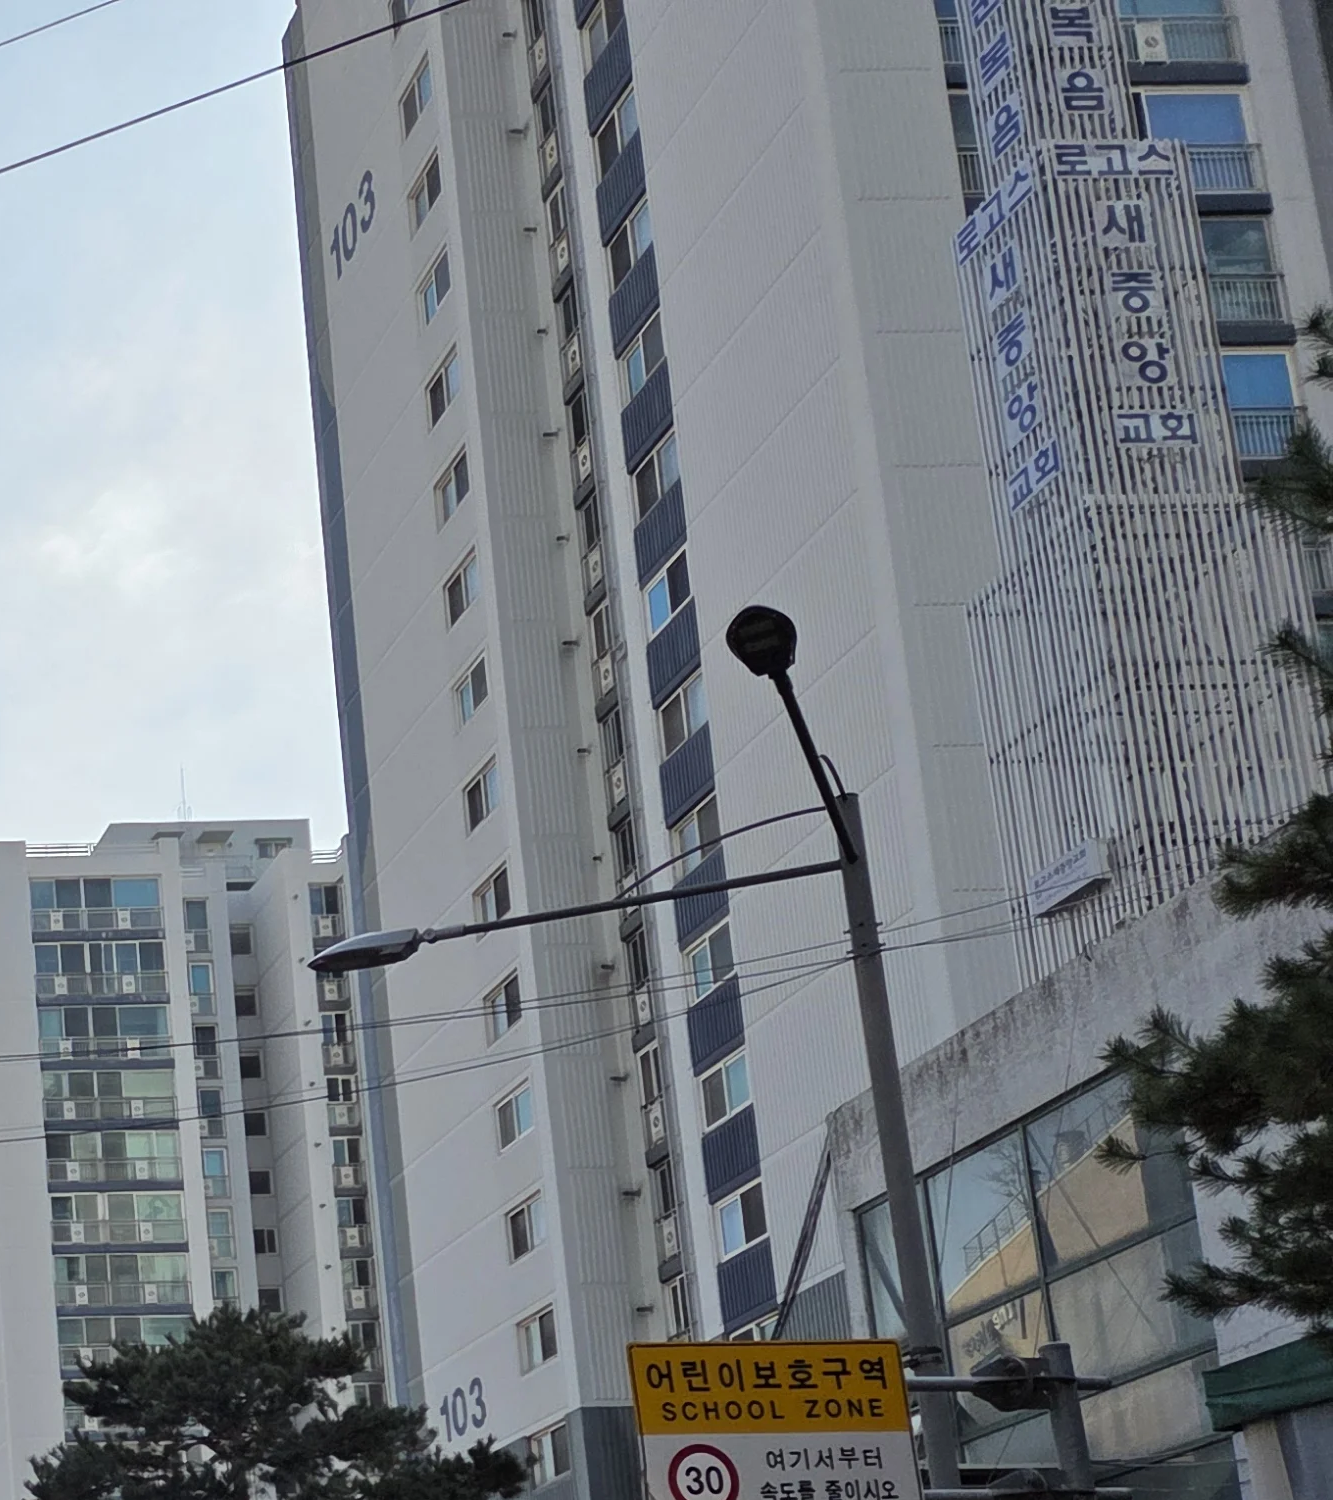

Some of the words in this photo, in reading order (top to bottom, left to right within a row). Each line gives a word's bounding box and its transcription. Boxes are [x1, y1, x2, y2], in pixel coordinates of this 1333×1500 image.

[1054, 143, 1173, 177] 로고스
[330, 170, 375, 280] 103
[957, 167, 1033, 266] 로고스
[1119, 411, 1198, 444] 교회
[1008, 440, 1061, 512] 교회
[646, 1356, 887, 1392] 어린이보호구역
[440, 1377, 486, 1442] 103
[662, 1400, 785, 1422] SCHOOL
[805, 1398, 884, 1419] ZONE
[766, 1447, 882, 1471] 여기서부터
[684, 1466, 724, 1495] 30
